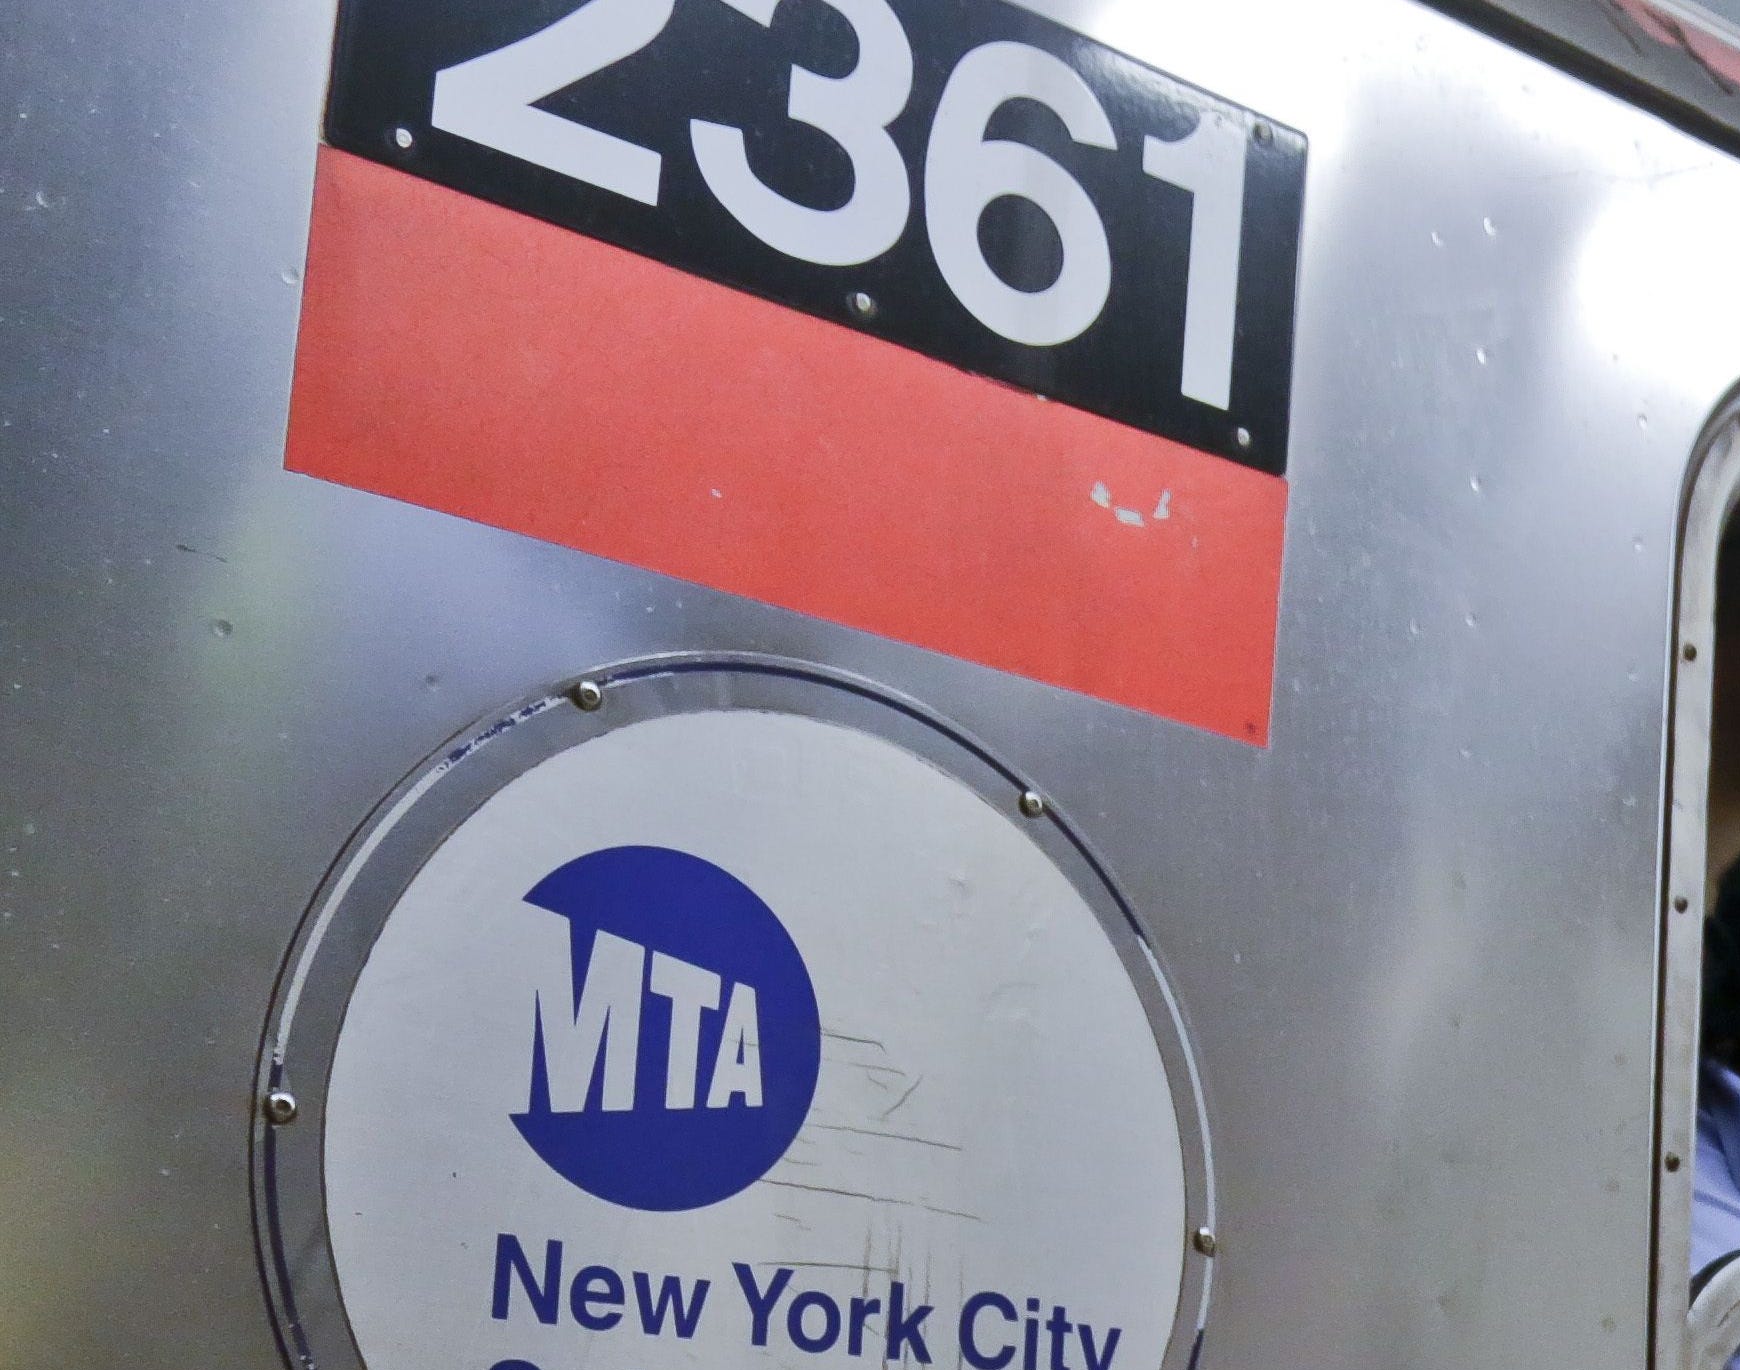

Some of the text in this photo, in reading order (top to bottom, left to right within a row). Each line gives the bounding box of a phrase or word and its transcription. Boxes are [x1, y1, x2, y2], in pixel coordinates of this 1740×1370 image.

[430, 0, 1247, 411] 2361
[507, 899, 763, 1115] MTA
[490, 1233, 712, 1338] New
[731, 1263, 933, 1364] York
